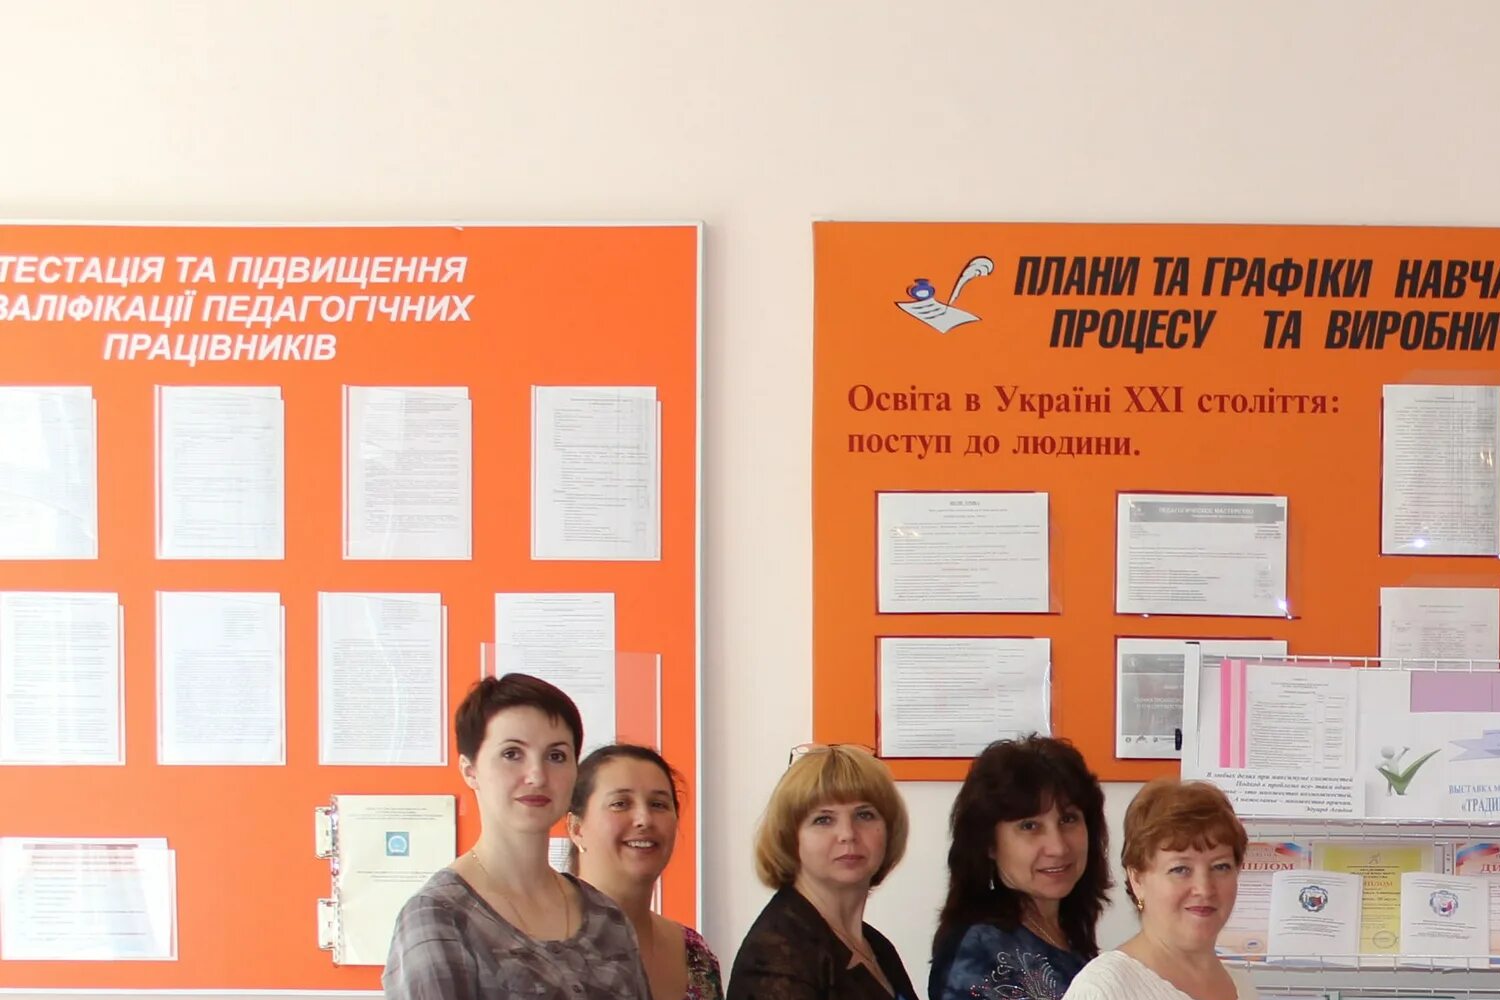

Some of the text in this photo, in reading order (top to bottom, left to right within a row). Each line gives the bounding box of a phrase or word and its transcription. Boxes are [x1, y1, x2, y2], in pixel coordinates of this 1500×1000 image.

[176, 255, 217, 284] ТА
[226, 255, 468, 288] ПІДВИЩЕННЯ
[1014, 256, 1141, 297] ПЛАНИ
[1153, 256, 1190, 297] ТА
[1201, 257, 1373, 299] ГРАФІКИ
[202, 294, 475, 326] ПЕДАГОГІЧНИХ
[1049, 309, 1217, 354] ПРОЦЕСУ
[1263, 310, 1302, 349] ТА
[102, 331, 337, 367] ПРАЦІВНИКІВ
[848, 384, 952, 412] Освіта
[965, 393, 981, 412] в
[993, 385, 1111, 419] Україні
[1197, 386, 1340, 414] століття:
[848, 433, 1141, 460] поступ до людини.
[1449, 784, 1492, 794] ВЫСТАВКА
